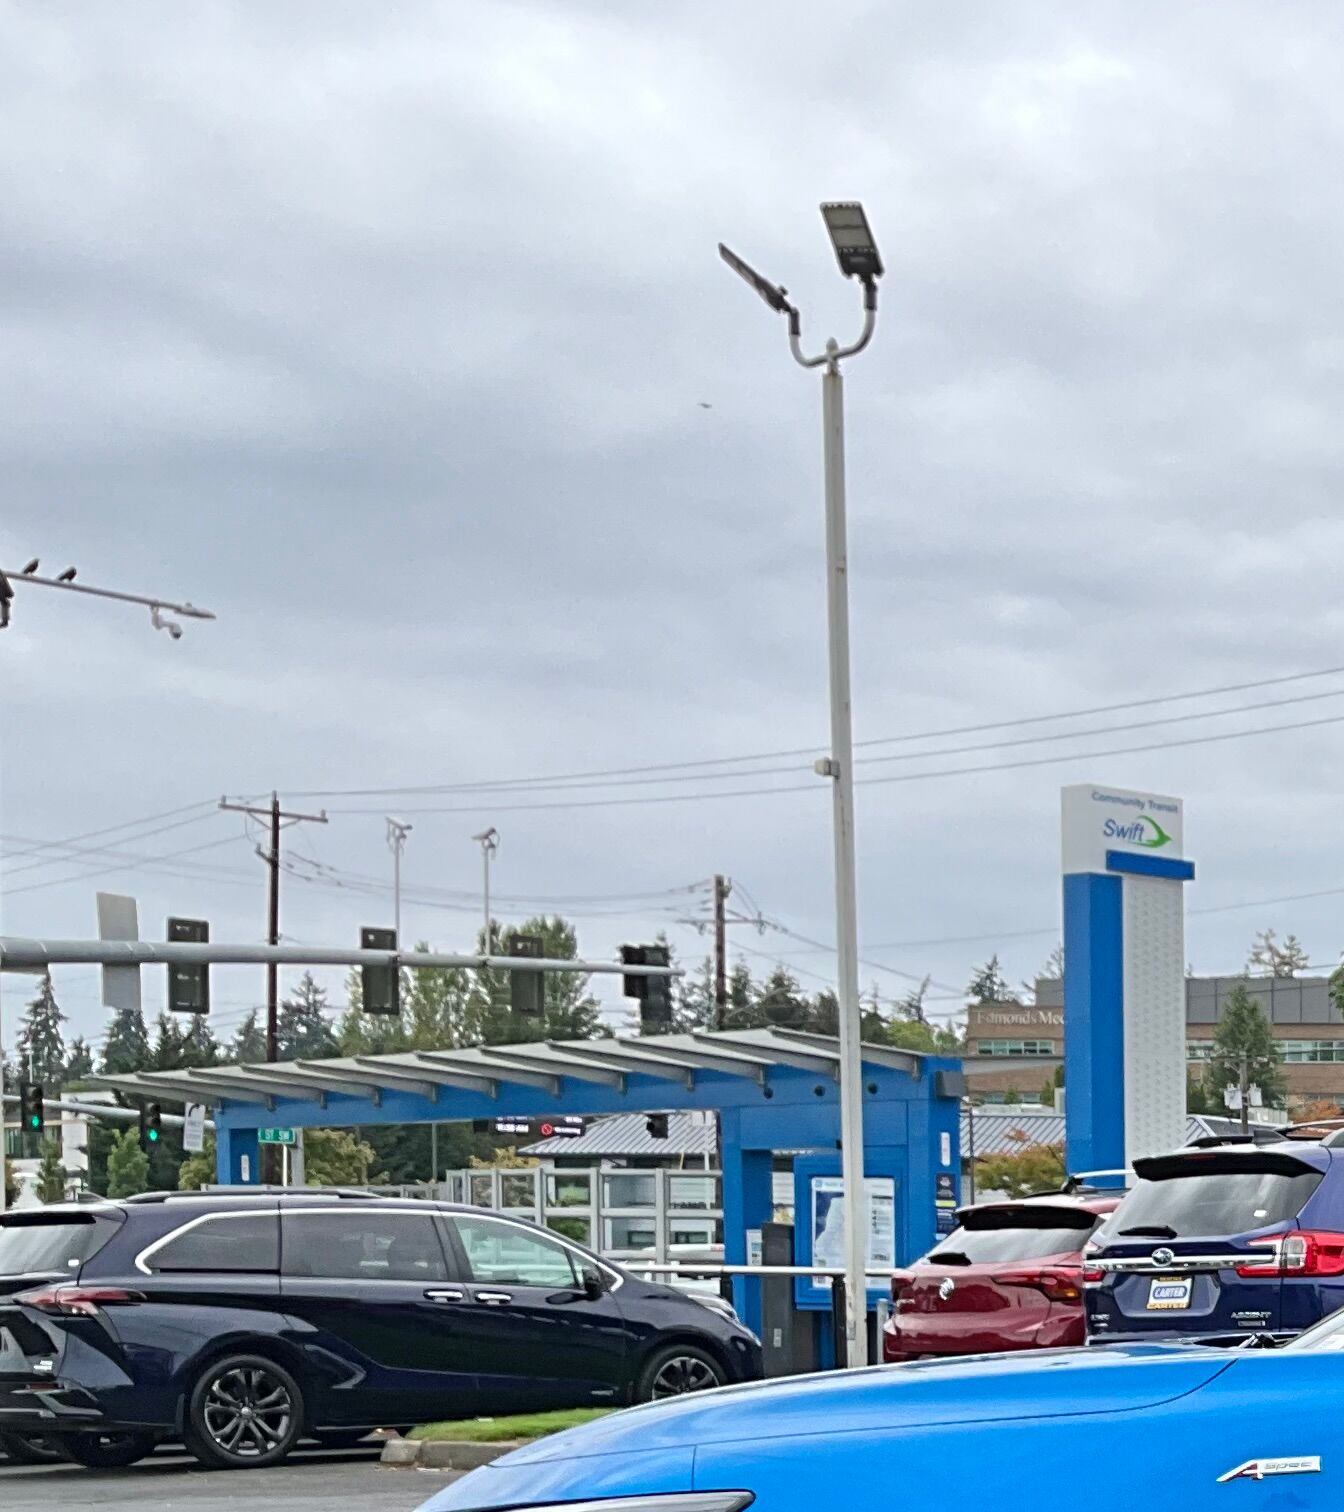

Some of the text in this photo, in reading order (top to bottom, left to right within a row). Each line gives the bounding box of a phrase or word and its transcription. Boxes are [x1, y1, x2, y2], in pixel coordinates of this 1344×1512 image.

[1091, 791, 1178, 814] Community Transit
[1103, 818, 1145, 842] Swift
[977, 1008, 1038, 1025] Edmonds
[1154, 1286, 1186, 1299] CARTER
